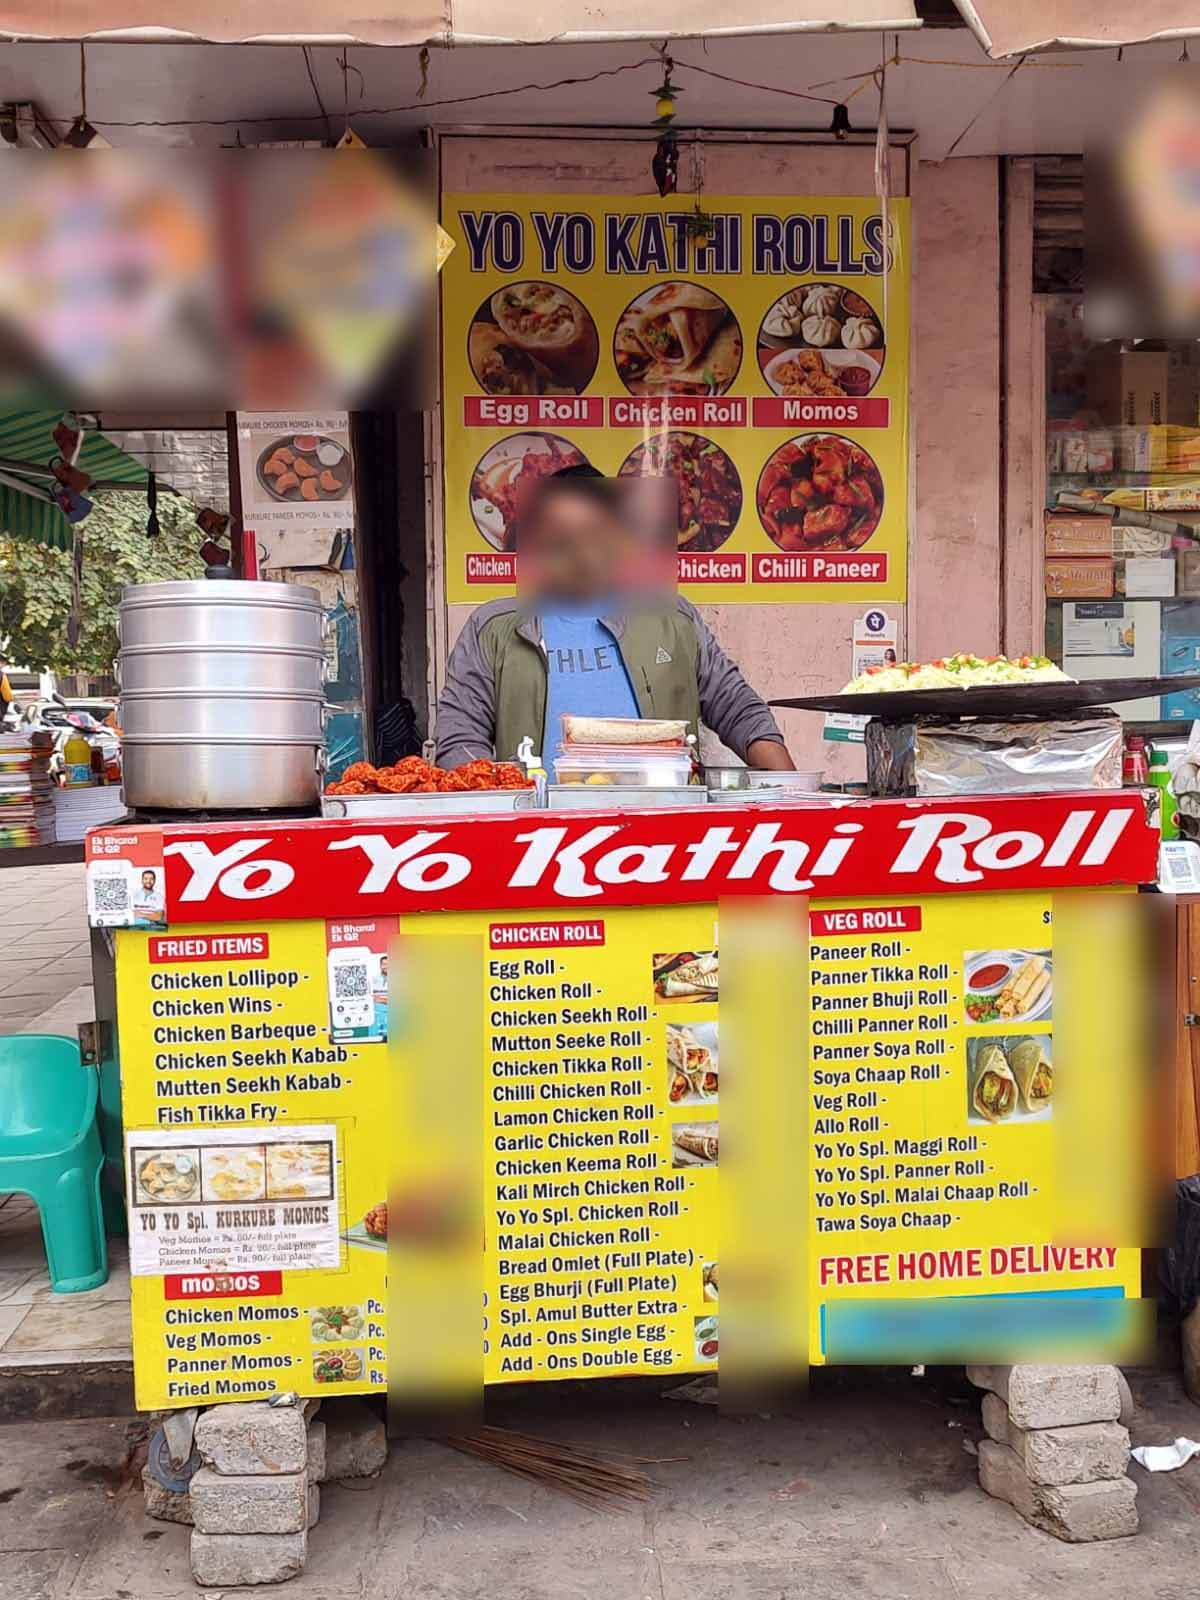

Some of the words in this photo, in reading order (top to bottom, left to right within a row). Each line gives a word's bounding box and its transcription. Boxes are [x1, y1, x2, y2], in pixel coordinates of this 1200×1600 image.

[460, 211, 523, 273] YO
[531, 212, 595, 273] YO
[605, 214, 741, 275] KATHI
[752, 214, 894, 276] ROLLS
[479, 400, 529, 424] Egg
[539, 399, 588, 419] Roll
[614, 401, 697, 423] Chicken
[703, 403, 742, 422] Roll
[783, 400, 859, 420] Momos
[467, 556, 511, 577] Chicken
[758, 557, 807, 578] Chilli
[813, 558, 881, 578] Paneer
[163, 838, 295, 902] Yo
[328, 831, 472, 894] Yo
[507, 823, 864, 897] Kathi
[889, 808, 1133, 884] Roll
[823, 913, 858, 931] VEG
[862, 911, 906, 929] ROLL
[491, 927, 560, 944] CHICKEN
[564, 925, 602, 941] ROLL
[157, 939, 207, 957] FRIED
[211, 937, 264, 955] ITEMS
[810, 946, 867, 961] Paneer
[871, 941, 901, 958] Roll
[151, 972, 223, 990] Chicken
[228, 969, 298, 988] Lollipop
[490, 961, 520, 980] Egg
[524, 959, 555, 975] Roll
[811, 970, 868, 986] Panner
[870, 966, 914, 982] Tikka
[918, 964, 948, 980] Roll
[490, 984, 556, 1002] Chicken
[561, 982, 592, 999] Roll
[152, 999, 224, 1017] Chicken
[228, 996, 272, 1013] Wins
[490, 1010, 557, 1027] Chicken
[562, 1007, 612, 1024] Seekh
[617, 1006, 647, 1022] Roll
[154, 1026, 226, 1044] Chicken
[230, 1023, 316, 1041] Barbeque
[812, 1018, 853, 1036] Chilli
[858, 1018, 914, 1033] Panner
[918, 1014, 948, 1030] Roll
[492, 1036, 551, 1052] Mutton
[556, 1032, 606, 1049] Seeke
[610, 1030, 641, 1046] Roll
[155, 1052, 227, 1070] Chicken
[232, 1049, 286, 1067] Seekh
[292, 1046, 348, 1064] Kabab
[492, 1060, 558, 1077] Chicken
[562, 1058, 606, 1074] Tikka
[611, 1055, 642, 1072] Roll
[157, 1080, 221, 1097] Mutten
[226, 1076, 280, 1094] Seekh
[286, 1073, 341, 1091] Kabab
[814, 1070, 850, 1088] Soya
[855, 1067, 906, 1084] Chaap
[910, 1064, 940, 1080] Roll
[813, 1095, 843, 1112] Veg
[847, 1092, 877, 1108] Roll
[158, 1106, 193, 1124] Fish
[197, 1104, 245, 1122] Tikka
[251, 1103, 277, 1122] Fry
[494, 1111, 548, 1126] Lamon
[552, 1107, 618, 1124] Chicken
[623, 1104, 654, 1120] Roll
[814, 1118, 844, 1134] Allo
[849, 1116, 879, 1132] Roll
[814, 1144, 833, 1159] Yo
[836, 1142, 855, 1158] Yo
[859, 1140, 889, 1159] Spl.
[894, 1137, 942, 1157] Maggi
[948, 1136, 977, 1152] Roll
[496, 1159, 562, 1176] Chicken
[566, 1157, 621, 1172] Keema
[626, 1153, 657, 1169] Roll
[496, 1184, 528, 1201] Kali
[533, 1182, 580, 1198] Mirch
[584, 1179, 650, 1196] Chicken
[654, 1176, 684, 1192] Roll
[815, 1192, 834, 1208] Yo
[837, 1191, 856, 1206] Yo
[860, 1189, 890, 1208] Spl.
[895, 1186, 939, 1203] Malai
[944, 1185, 994, 1201] Chaap
[999, 1182, 1028, 1197] Roll
[140, 1213, 156, 1231] YO
[164, 1212, 180, 1230] YO
[187, 1212, 208, 1233] Spl.
[216, 1209, 276, 1229] KURKURE
[283, 1206, 329, 1225] MOMOS
[496, 1210, 516, 1226] Yo
[519, 1209, 538, 1224] Yo
[542, 1207, 574, 1226] Spl.
[578, 1204, 644, 1221] Chicken
[648, 1200, 678, 1217] Roll
[816, 1217, 855, 1232] Tawa
[860, 1214, 896, 1232] Soya
[901, 1212, 952, 1228] Chaap
[499, 1258, 547, 1275] Bread
[552, 1255, 600, 1272] Omlet
[604, 1252, 640, 1272] (Full
[646, 1249, 694, 1266] Plate)
[820, 1254, 890, 1286] FREE
[898, 1249, 982, 1281] HOME
[990, 1245, 1118, 1275] DELIVERY
[500, 1284, 530, 1302] Egg
[534, 1280, 582, 1299] Bhurji
[587, 1277, 623, 1298] (Full
[628, 1274, 676, 1292] Plate)
[166, 1308, 233, 1324] Chicken
[238, 1306, 299, 1321] Momos
[500, 1308, 532, 1327] Spl.
[536, 1305, 577, 1322] Amul
[582, 1302, 633, 1319] Butter
[637, 1300, 678, 1315] Extra
[166, 1334, 197, 1352] Veg
[201, 1332, 262, 1348] Momos
[500, 1332, 532, 1348] Add
[546, 1330, 577, 1345] Ons
[582, 1326, 632, 1344] Single
[636, 1324, 666, 1342] Egg
[168, 1358, 226, 1373] Panner
[232, 1354, 292, 1370] Momos
[501, 1356, 532, 1372] Add
[547, 1354, 578, 1370] Ons
[582, 1350, 638, 1366] Double
[643, 1348, 673, 1366] Egg
[168, 1381, 210, 1397] Fried
[216, 1380, 276, 1394] Momos
